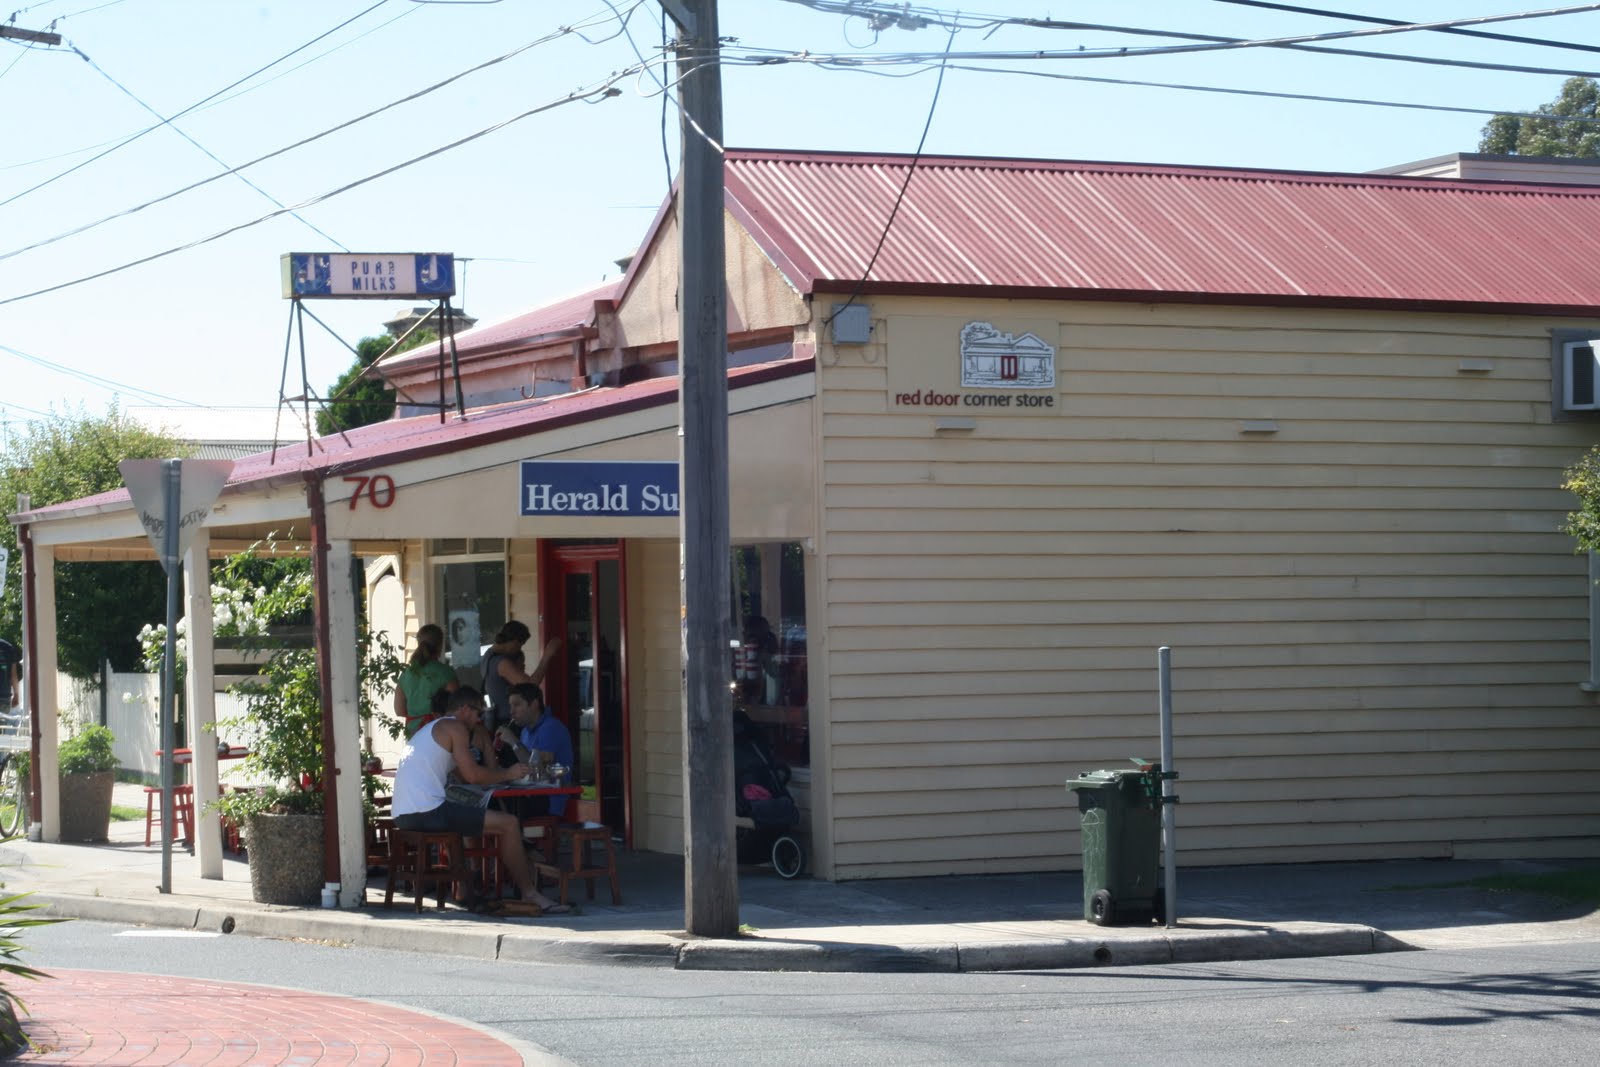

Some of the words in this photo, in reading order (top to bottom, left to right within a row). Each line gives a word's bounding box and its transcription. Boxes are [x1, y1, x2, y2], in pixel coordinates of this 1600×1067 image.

[352, 277, 396, 290] MILKS
[895, 389, 921, 406] red
[923, 389, 961, 406] door
[963, 394, 1013, 407] corner
[1016, 393, 1054, 407] store
[343, 474, 396, 511] 70
[526, 484, 629, 511] Herald
[641, 484, 680, 511] Su
